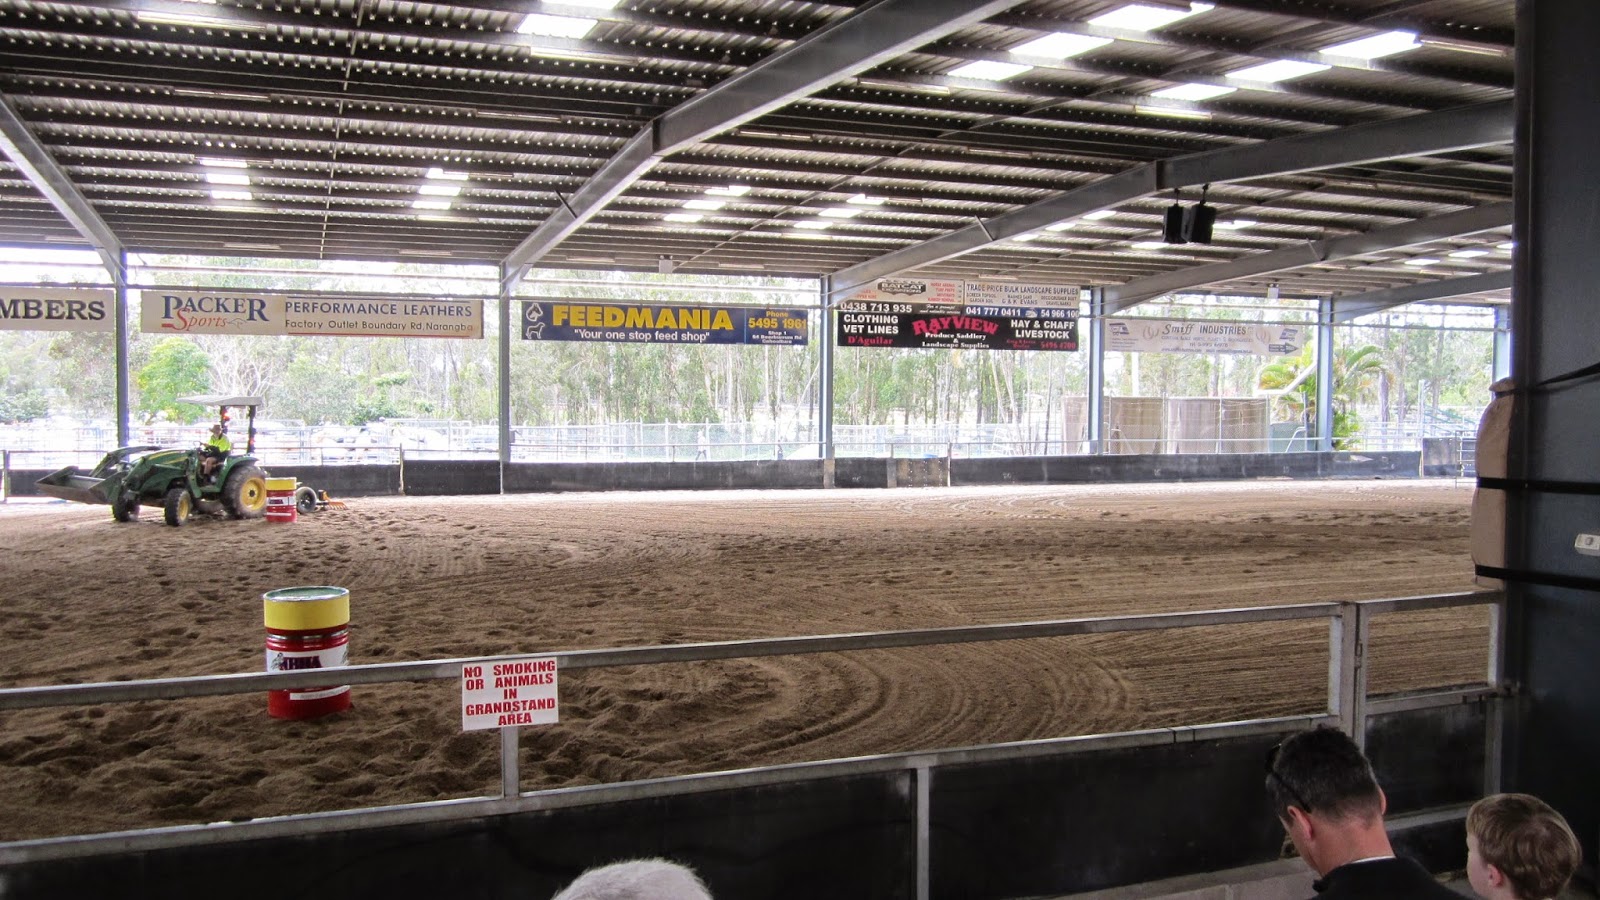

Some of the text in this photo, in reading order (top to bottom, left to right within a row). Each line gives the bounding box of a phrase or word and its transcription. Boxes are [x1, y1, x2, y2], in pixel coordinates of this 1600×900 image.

[0, 299, 106, 320] MBERS
[161, 295, 270, 322] PACKER
[285, 302, 472, 317] PERFORMANCE LEATHERS
[840, 302, 912, 313] 0438 713 935
[966, 307, 980, 315] 041
[984, 307, 999, 315] 777
[1001, 308, 1020, 316] 0411
[1041, 309, 1050, 317] 54
[162, 308, 228, 331] Sports
[552, 304, 734, 330] FEEDMANIA
[844, 314, 898, 324] CLOTHING
[285, 320, 323, 330] Factory
[328, 320, 358, 329] Outlet
[362, 321, 407, 332] Boundary
[426, 322, 473, 332] Narangba
[748, 318, 807, 329] 5495 1961
[843, 325, 899, 334] VET LINES
[912, 316, 999, 335] RAYVIEW
[1011, 320, 1074, 329] HAY & CHAFF
[1162, 324, 1196, 334] Smiff
[1199, 325, 1247, 335] INDUSTRIES
[574, 329, 710, 343] "Your one stop feed shop"
[1016, 330, 1069, 339] LIVESTOCK
[848, 336, 893, 346] D'Aguilar
[464, 660, 555, 678] NO SMOKING
[466, 673, 554, 690] OR ANIMALS
[504, 688, 517, 699] IN
[466, 698, 555, 716] GRANDSTAND
[498, 712, 532, 725] AREA
